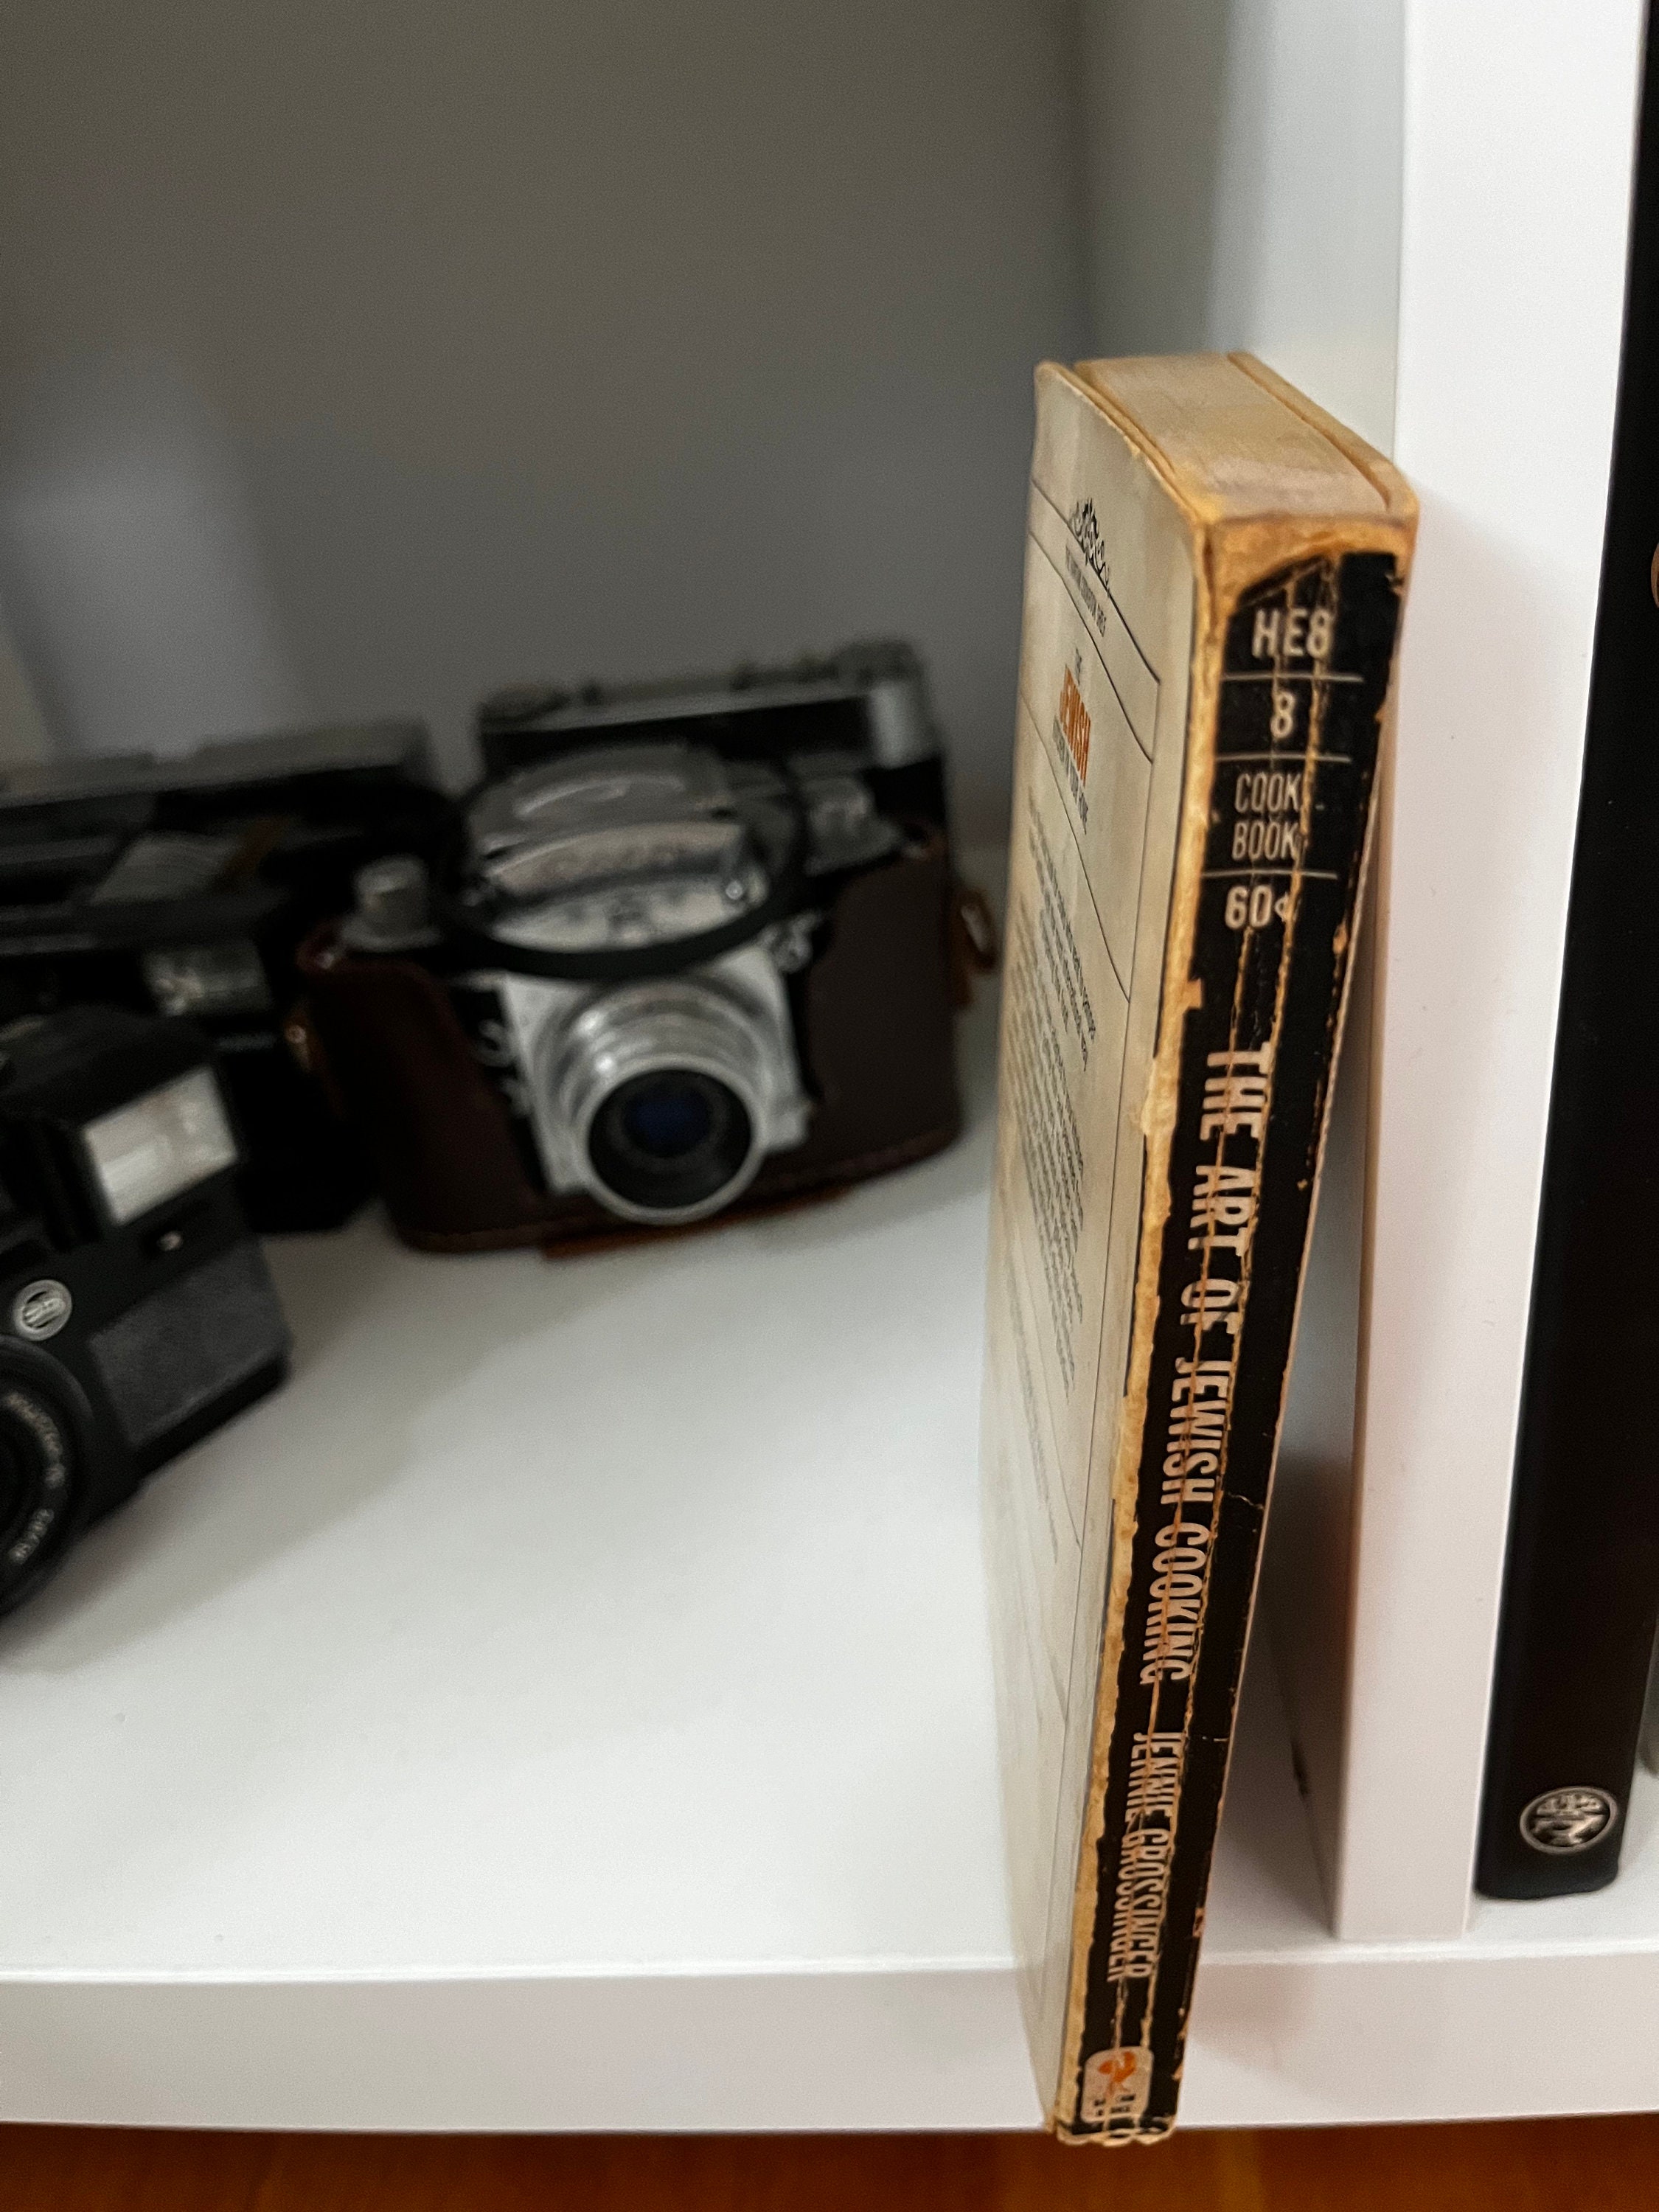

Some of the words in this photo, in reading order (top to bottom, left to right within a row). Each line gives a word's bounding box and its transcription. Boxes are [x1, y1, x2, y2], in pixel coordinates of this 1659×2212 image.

[1252, 608, 1333, 658] HE8
[1270, 692, 1296, 739] 8
[1234, 772, 1302, 813] COOK
[1231, 821, 1301, 860] BOOK
[1200, 1041, 1271, 1141] THE
[1187, 1165, 1258, 1257] ART
[1180, 1278, 1243, 1335] OF
[1161, 1357, 1232, 1505] JEWISH
[1140, 1522, 1209, 1685] COOKING
[1124, 1732, 1183, 1823] JENNIE
[1106, 1828, 1169, 1983] GROSSINGER
